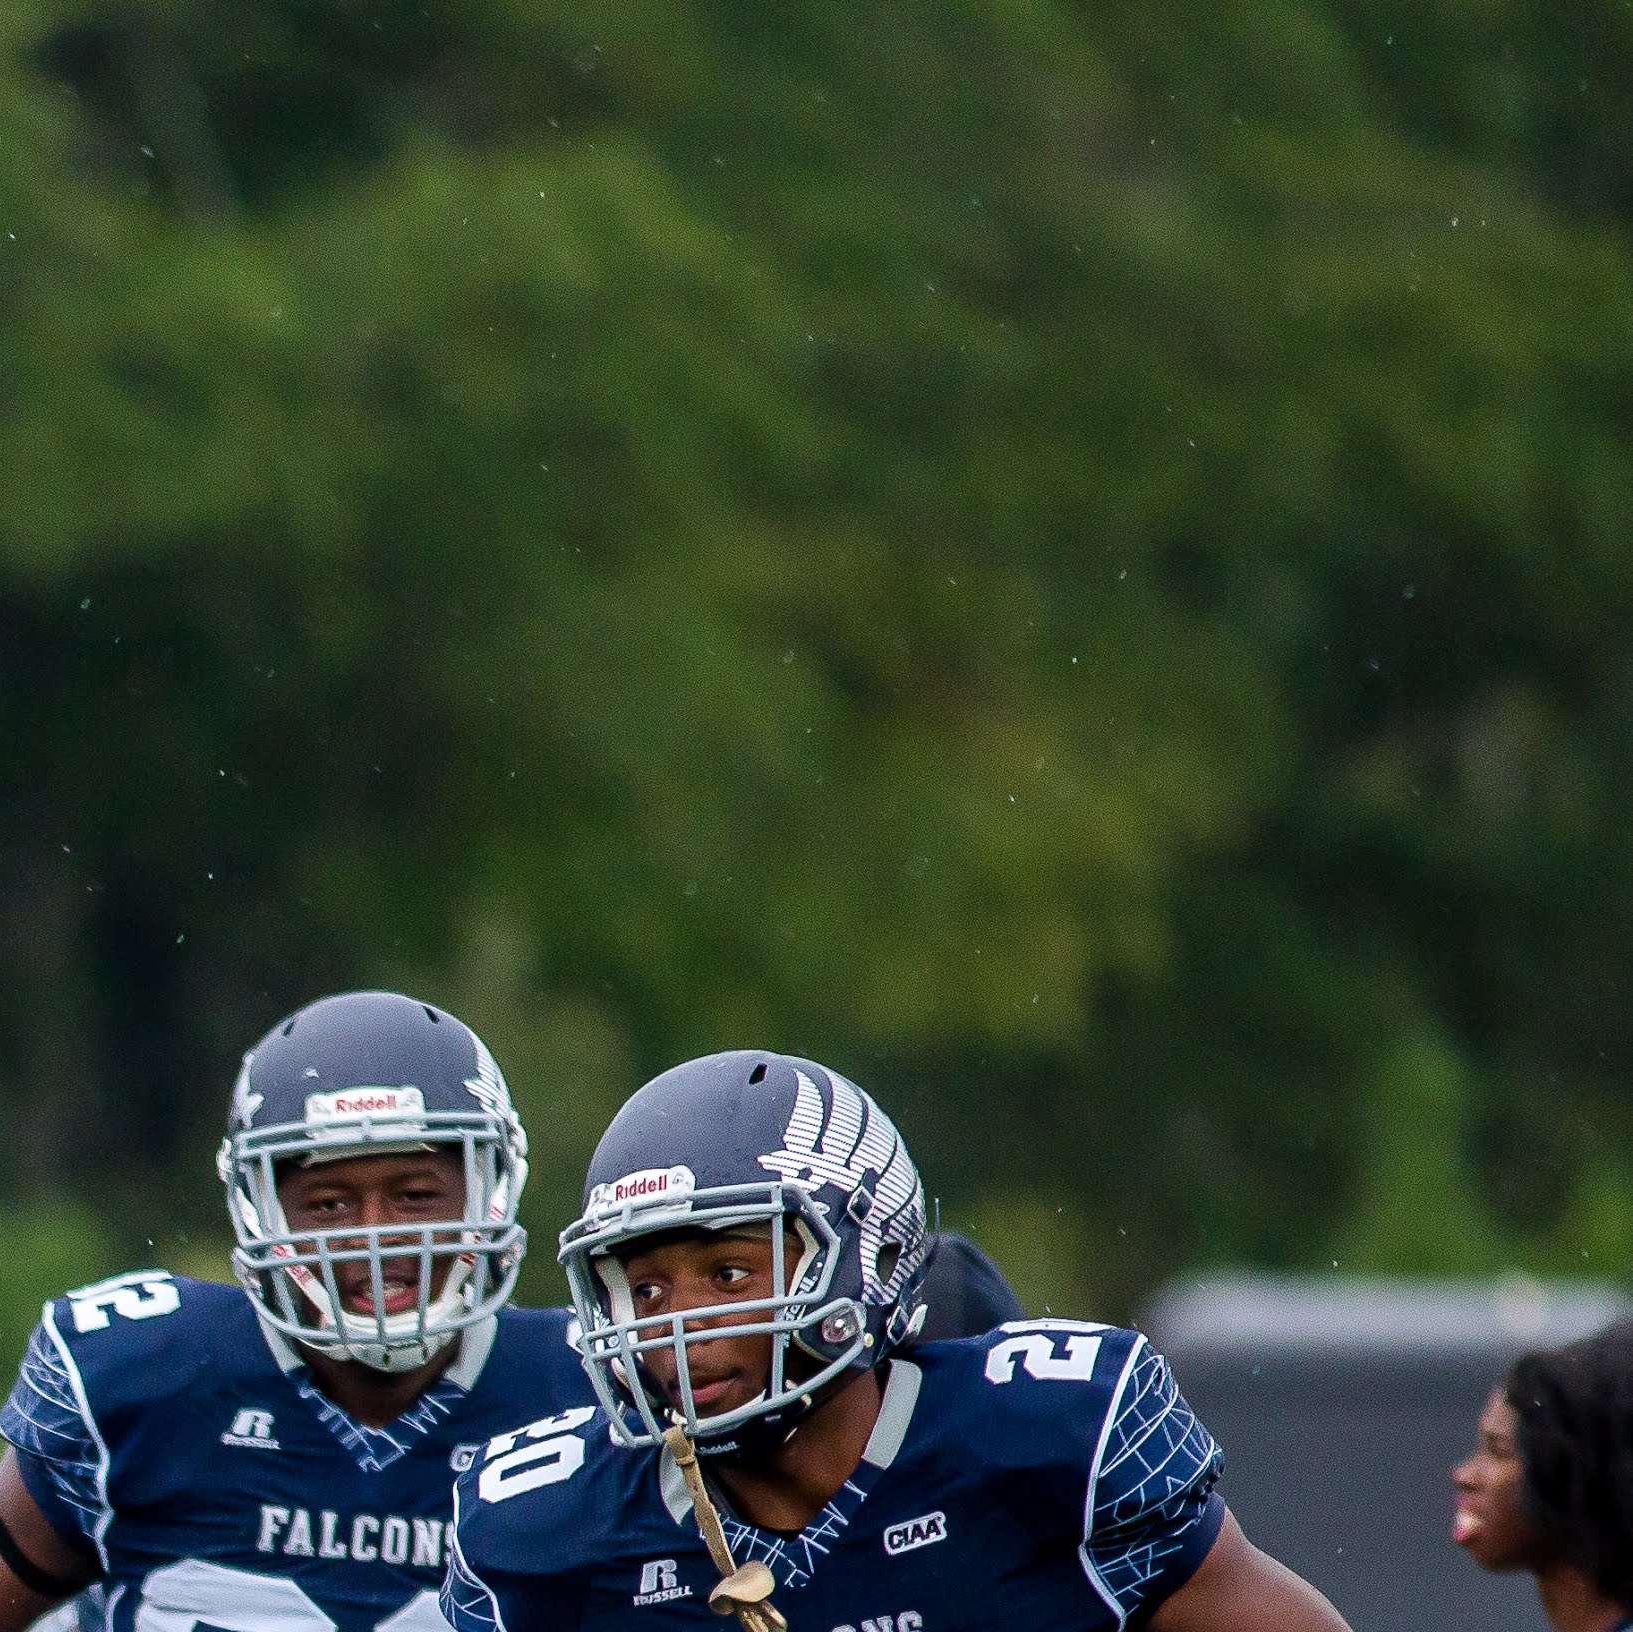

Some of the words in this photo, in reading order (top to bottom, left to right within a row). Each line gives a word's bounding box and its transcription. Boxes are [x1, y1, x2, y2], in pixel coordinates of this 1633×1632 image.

[615, 1174, 668, 1200] Riddell
[886, 1515, 943, 1551] CIAA
[633, 1584, 693, 1607] RUSSELL
